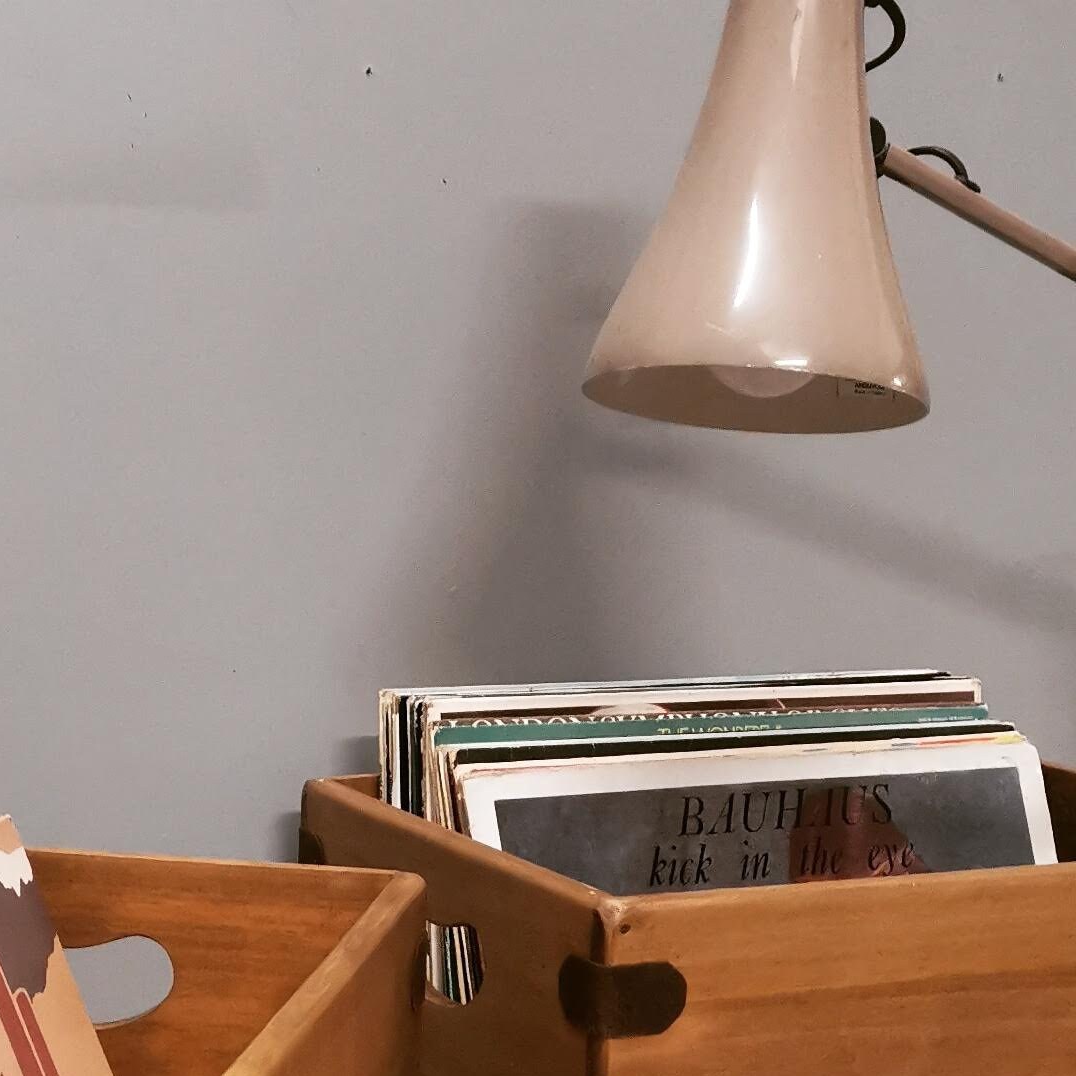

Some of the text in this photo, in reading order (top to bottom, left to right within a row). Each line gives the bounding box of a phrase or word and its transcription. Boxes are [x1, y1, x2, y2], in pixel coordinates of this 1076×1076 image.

[679, 783, 893, 836] BAUHAUS
[649, 836, 915, 887] kick in the eye
